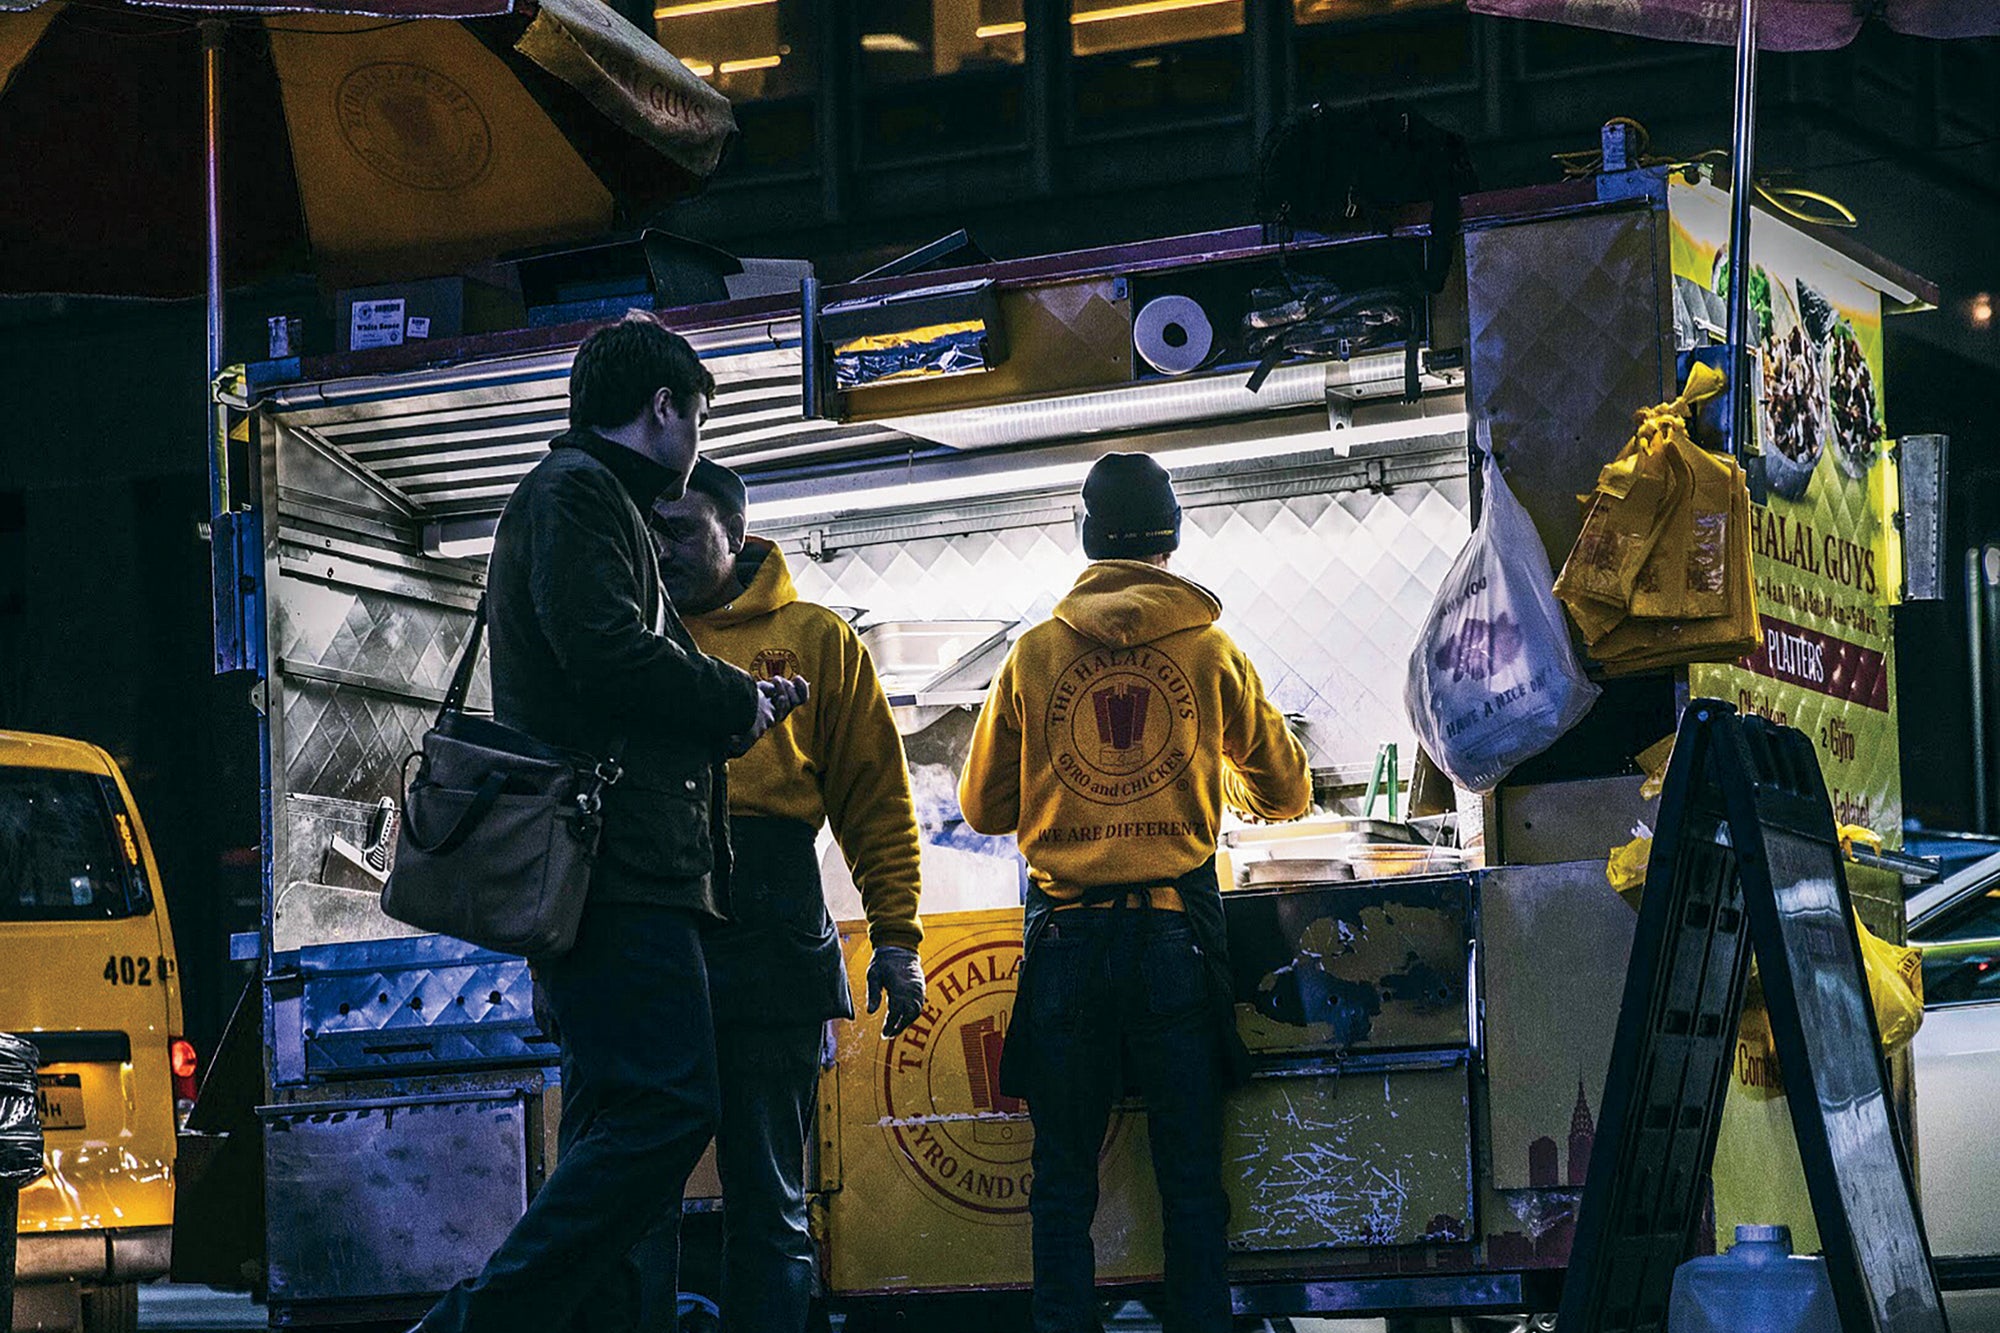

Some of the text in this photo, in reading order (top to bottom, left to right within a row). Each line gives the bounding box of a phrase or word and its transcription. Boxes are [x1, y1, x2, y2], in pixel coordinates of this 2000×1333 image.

[650, 82, 706, 131] GUYS
[1751, 506, 1876, 595] HALAL GUYS
[1767, 629, 1825, 684] PLATTERS
[1052, 648, 1195, 725] THE HALAL GUYS
[1484, 701, 1494, 718] A
[1495, 683, 1526, 709] NICE
[1830, 717, 1855, 763] Gyro
[1058, 747, 1186, 797] GYRO and CHICKEN
[1038, 820, 1205, 842] WE ARE DIFFERENT
[899, 954, 1024, 1074] THE HALA
[957, 1169, 1015, 1199] AND
